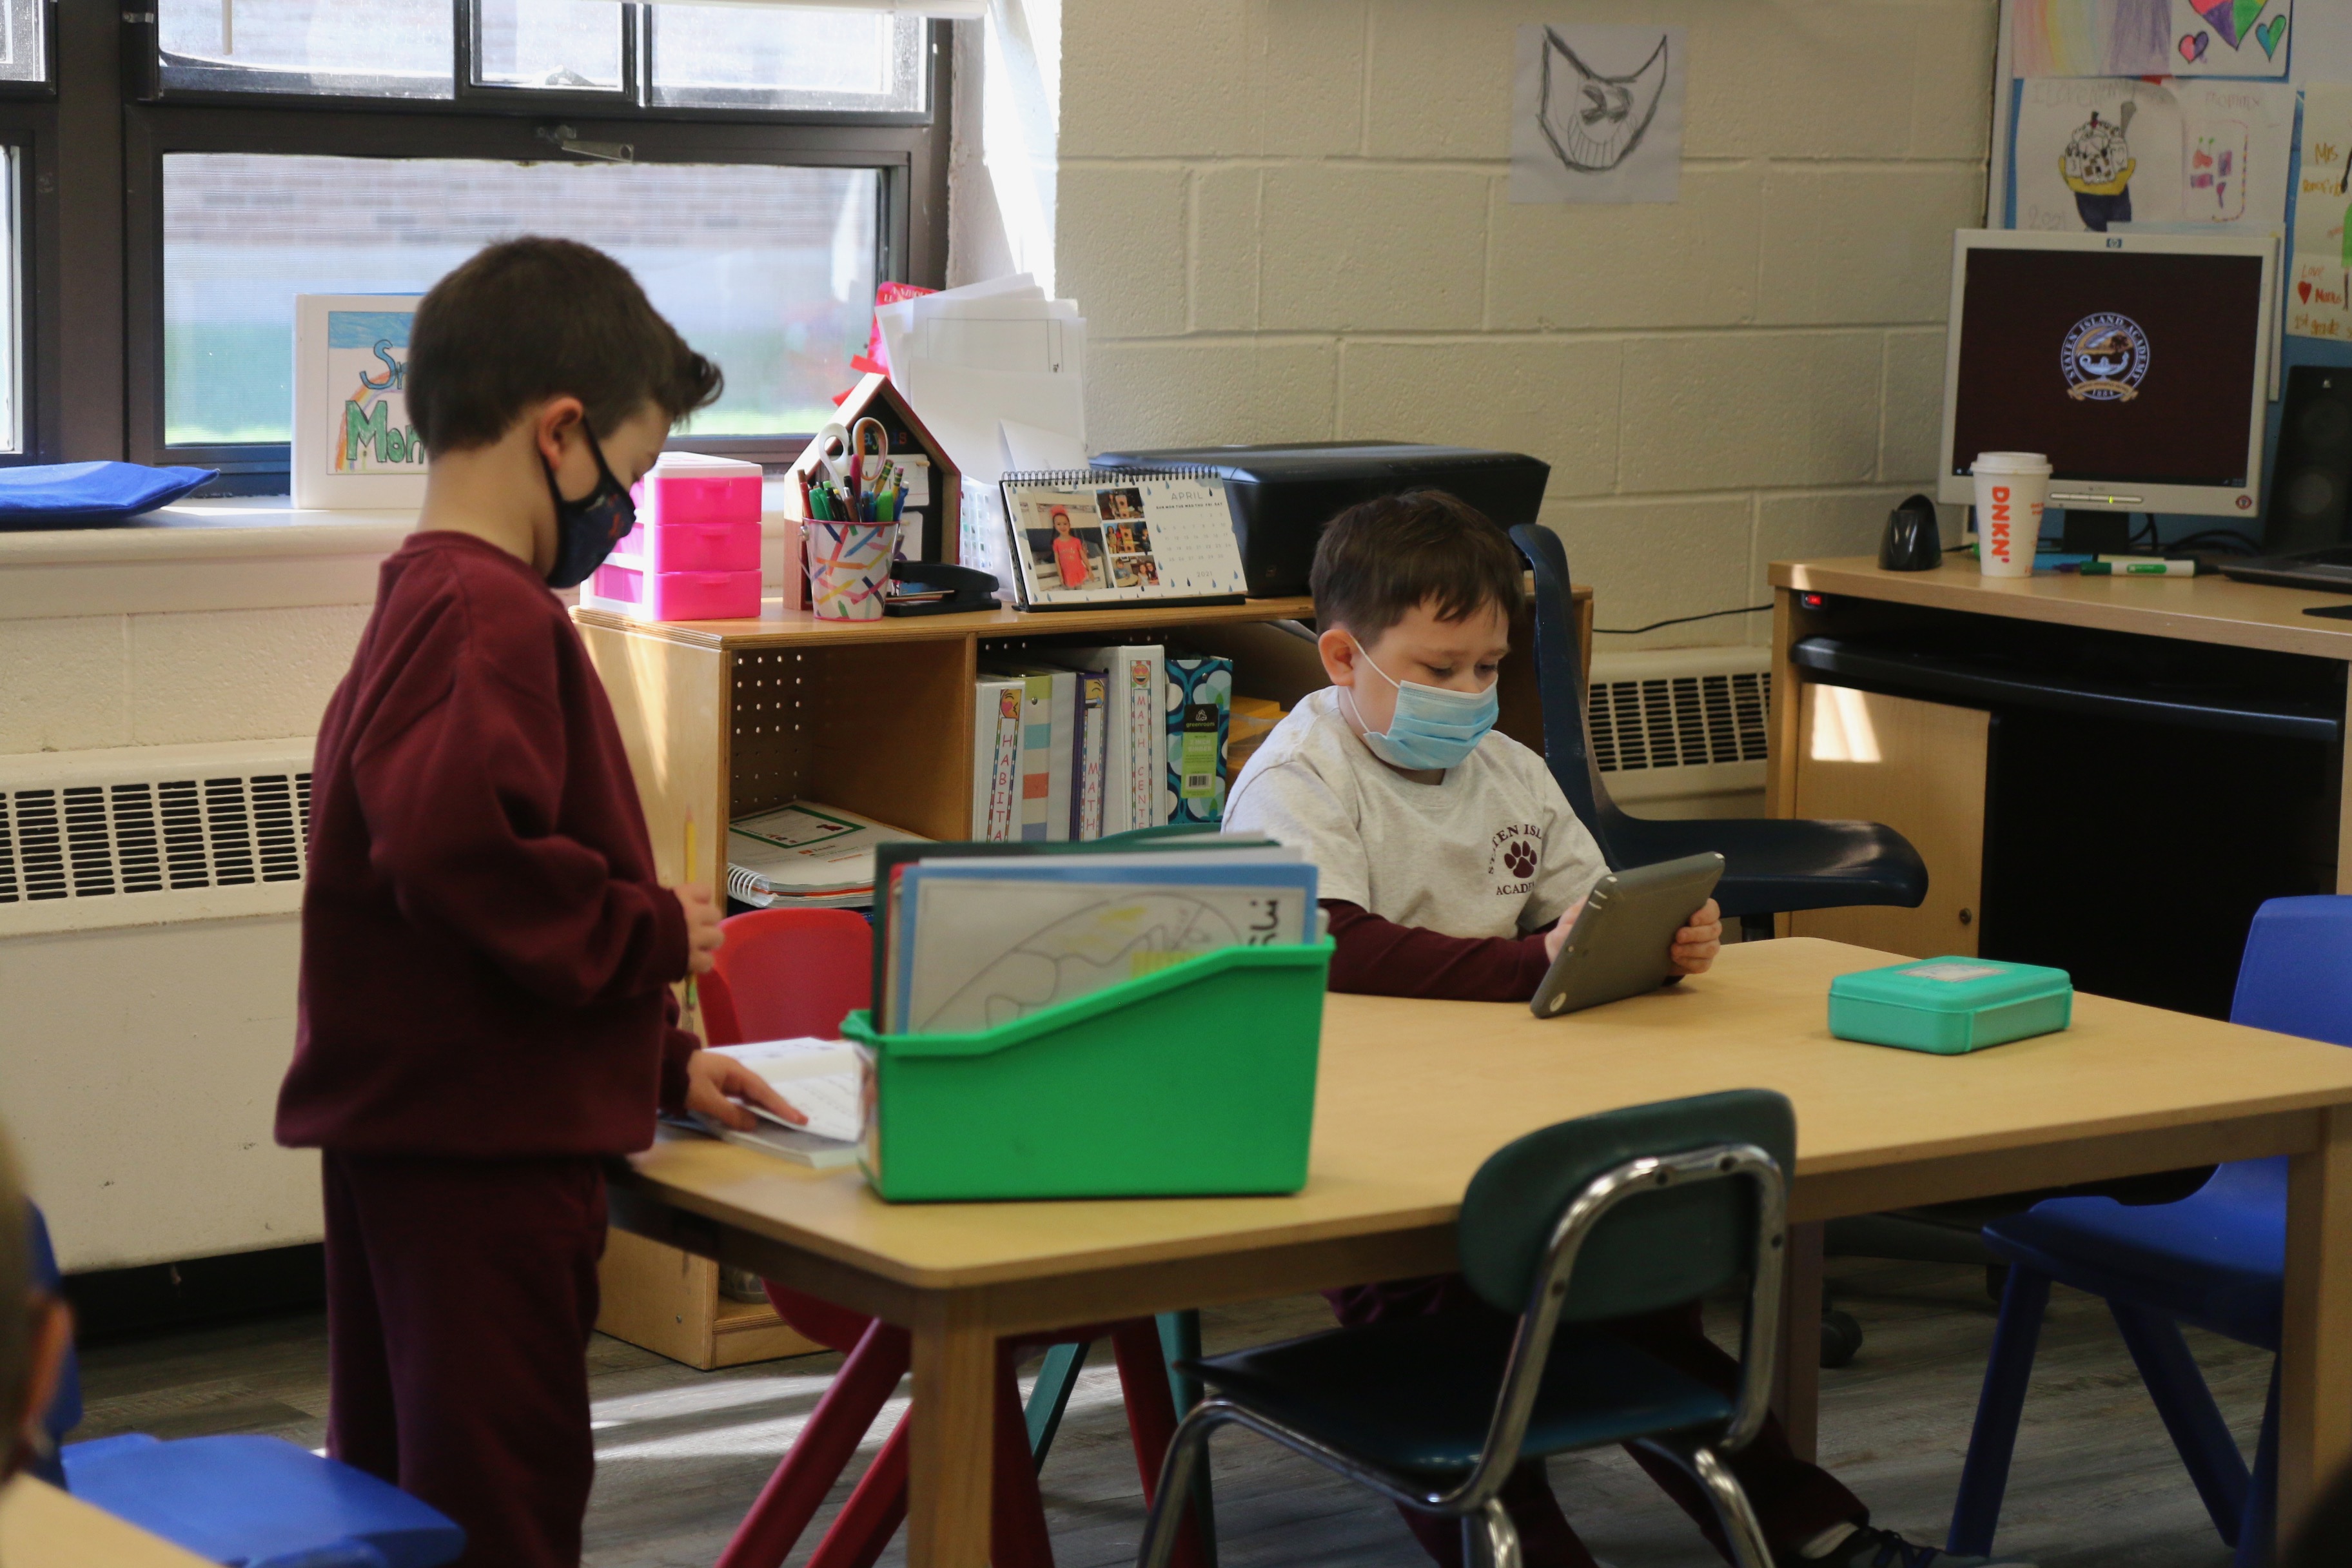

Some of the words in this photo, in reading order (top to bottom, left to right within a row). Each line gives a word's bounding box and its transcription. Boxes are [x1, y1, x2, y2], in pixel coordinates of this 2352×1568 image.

[1171, 492, 1203, 500] APRIL
[1137, 696, 1146, 748] MATH
[1086, 762, 1099, 831] MATH
